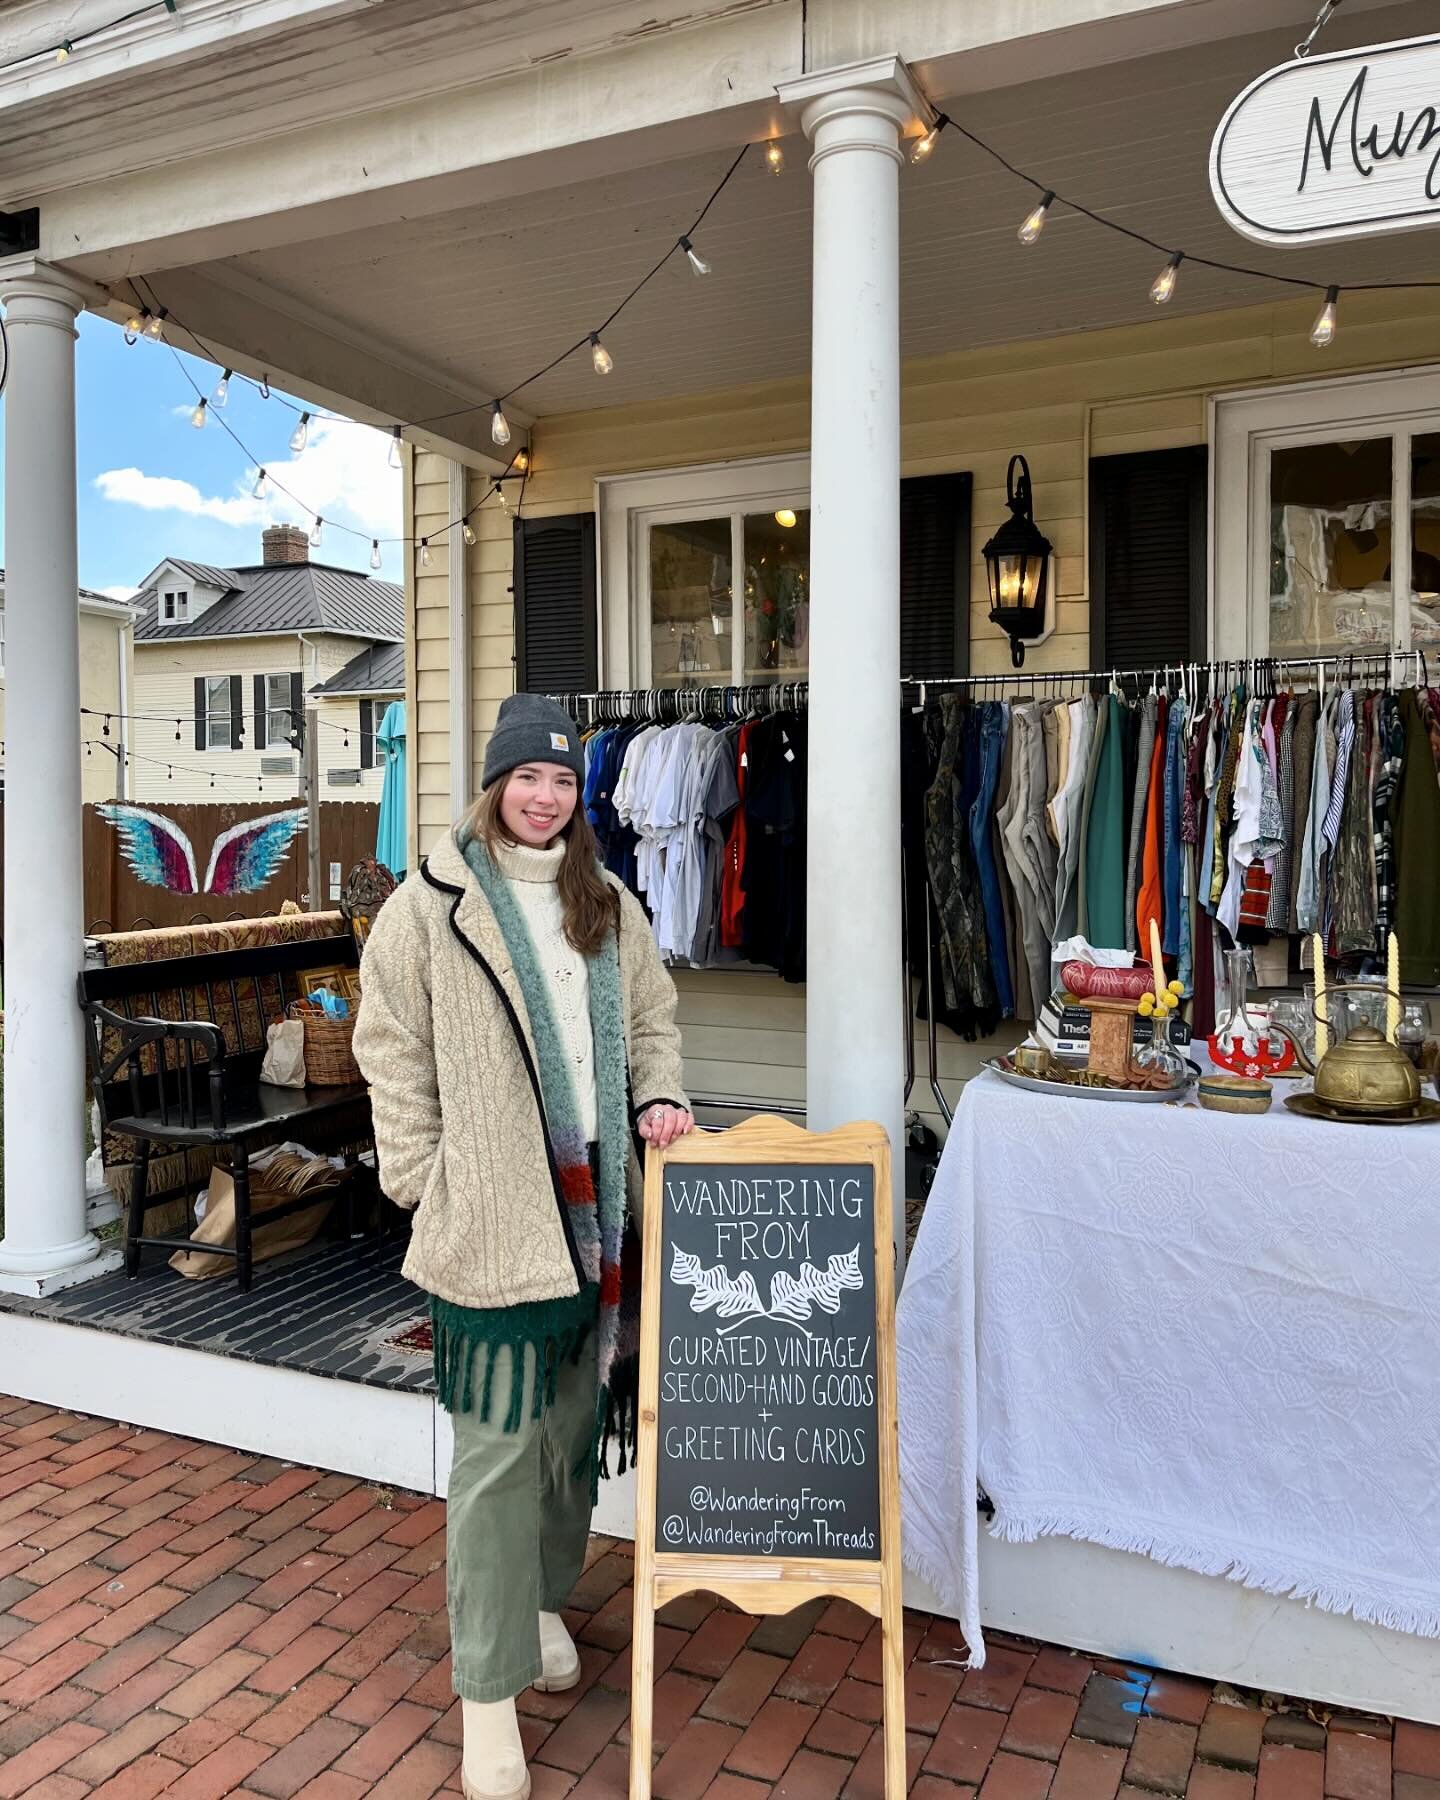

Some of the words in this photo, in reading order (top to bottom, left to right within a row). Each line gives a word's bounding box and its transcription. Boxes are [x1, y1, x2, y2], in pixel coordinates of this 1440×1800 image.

[665, 1178, 864, 1218] WANDERING
[714, 1220, 812, 1260] FROM
[668, 1335, 767, 1366] CURATED
[774, 1335, 871, 1368] VINTAGE/
[661, 1372, 806, 1405] SECOND-HAND
[812, 1374, 874, 1407] GOODS
[757, 1407, 774, 1423] +
[665, 1426, 785, 1462] GREETING
[795, 1427, 866, 1466] CARDS
[689, 1485, 846, 1521] @WanderingFrom
[662, 1514, 875, 1554] @WanderingFromThreads
